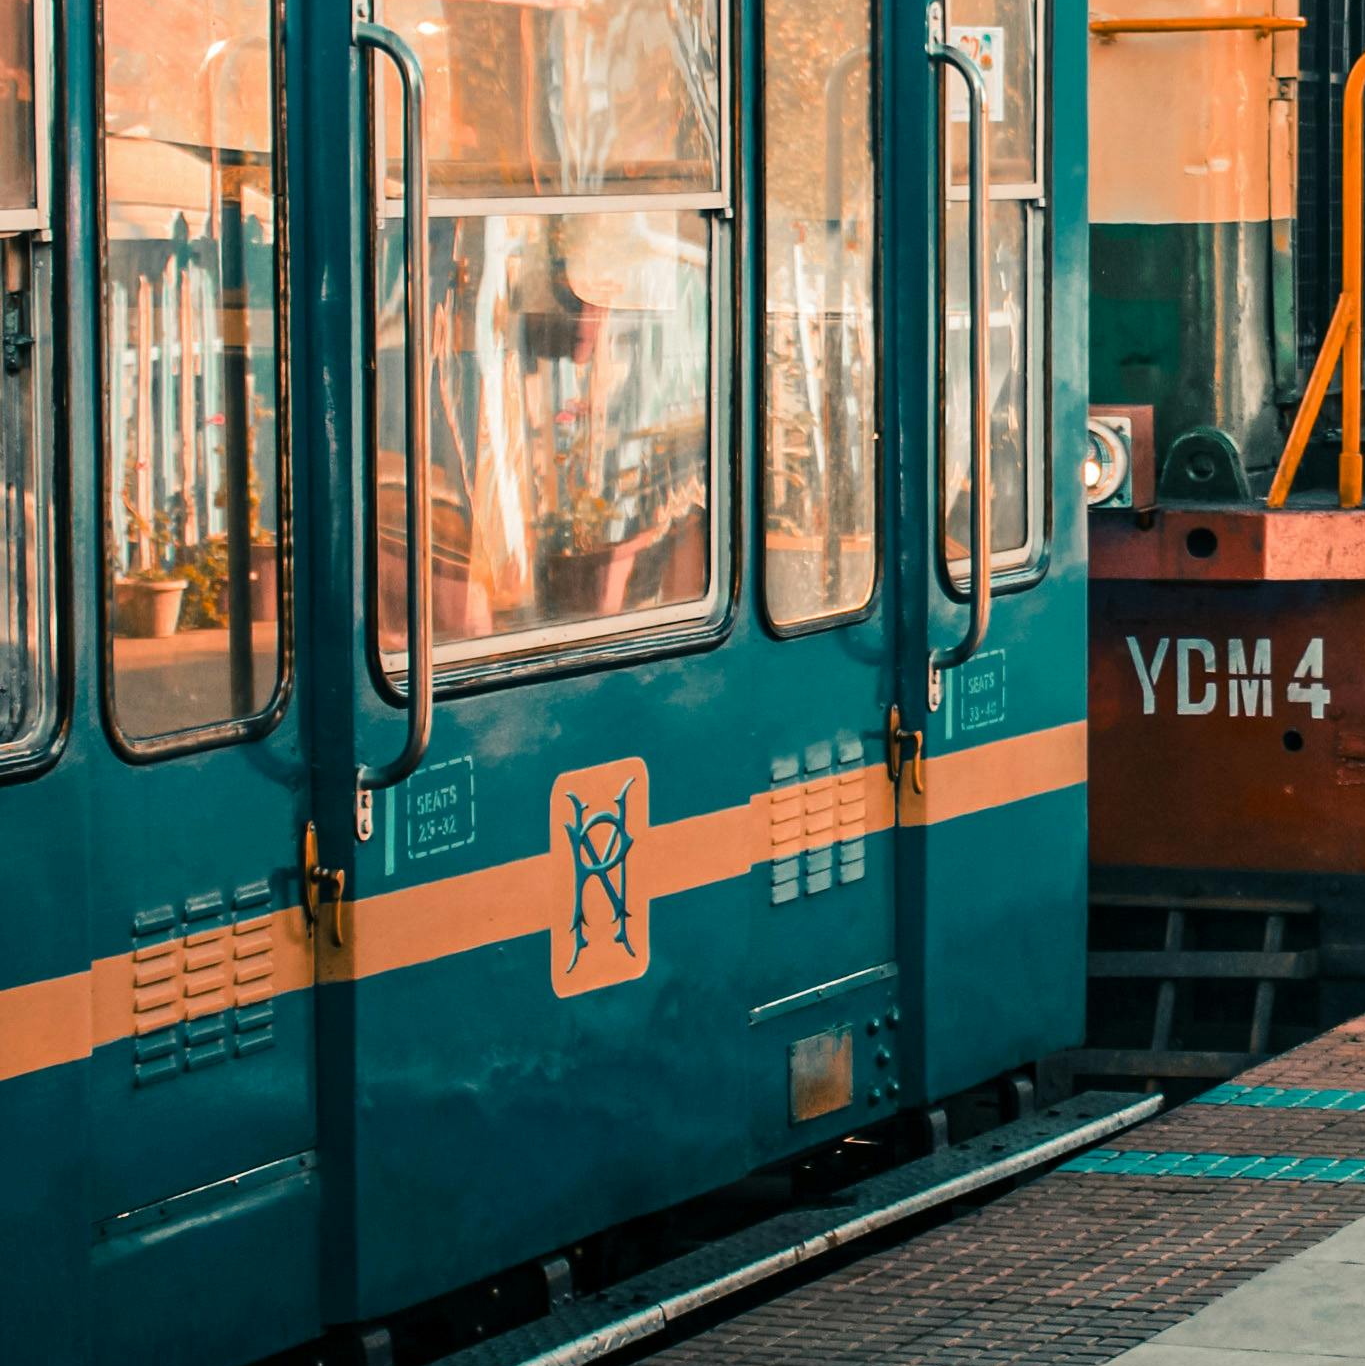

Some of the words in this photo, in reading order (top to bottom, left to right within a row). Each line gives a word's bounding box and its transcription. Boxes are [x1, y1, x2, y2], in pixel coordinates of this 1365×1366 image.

[968, 671, 995, 694] SEATS
[1126, 636, 1273, 717] YDM
[1287, 637, 1331, 719] 4
[416, 784, 457, 815] SEATS
[417, 814, 457, 843] 25-32
